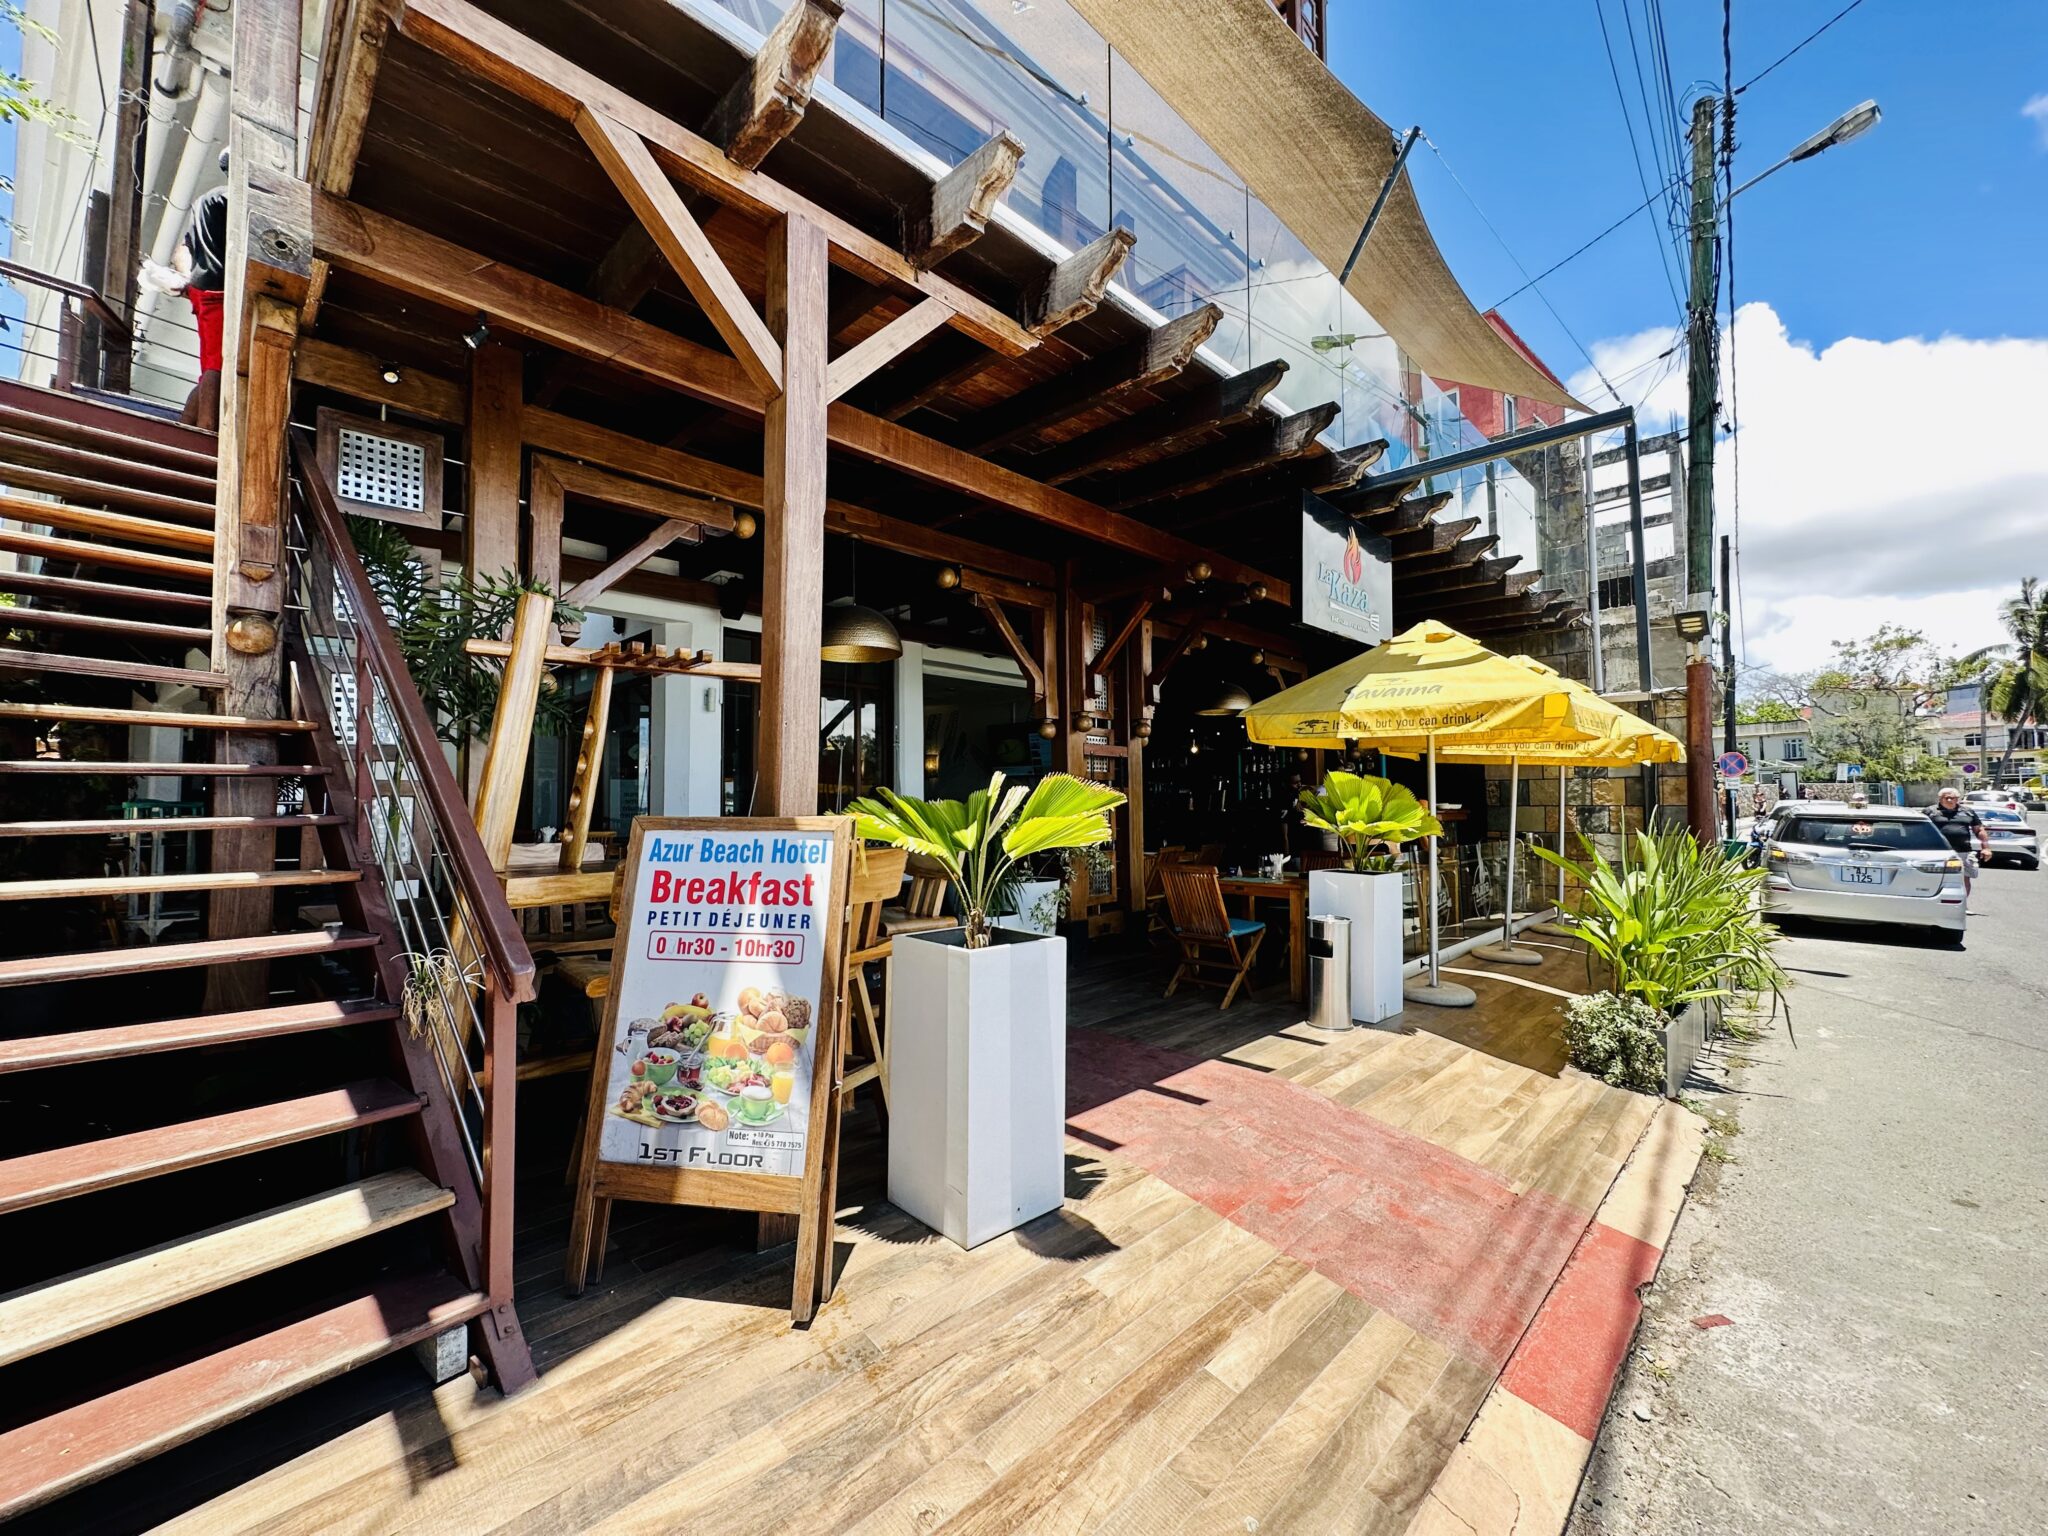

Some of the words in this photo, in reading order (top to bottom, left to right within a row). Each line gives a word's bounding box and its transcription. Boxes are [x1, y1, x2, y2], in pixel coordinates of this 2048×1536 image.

[1329, 569, 1369, 613] Kaza
[1338, 684, 1443, 704] Savanna
[1332, 719, 1349, 729] It's
[1375, 718, 1391, 728] but
[1396, 718, 1415, 729] you
[1419, 716, 1437, 727] can
[1442, 711, 1471, 724] drink
[1514, 741, 1530, 751] you
[1534, 741, 1551, 749] can
[1554, 740, 1579, 750] drink
[648, 838, 694, 862] Azur
[701, 838, 764, 864] Beach
[771, 838, 828, 865] Hotel
[1850, 873, 1873, 883] 1125
[650, 870, 815, 907] Breakfast
[647, 910, 702, 926] PETIT
[708, 908, 811, 929] DÉJEUNER
[735, 938, 796, 958] 10hr30
[728, 1130, 750, 1141] Note:
